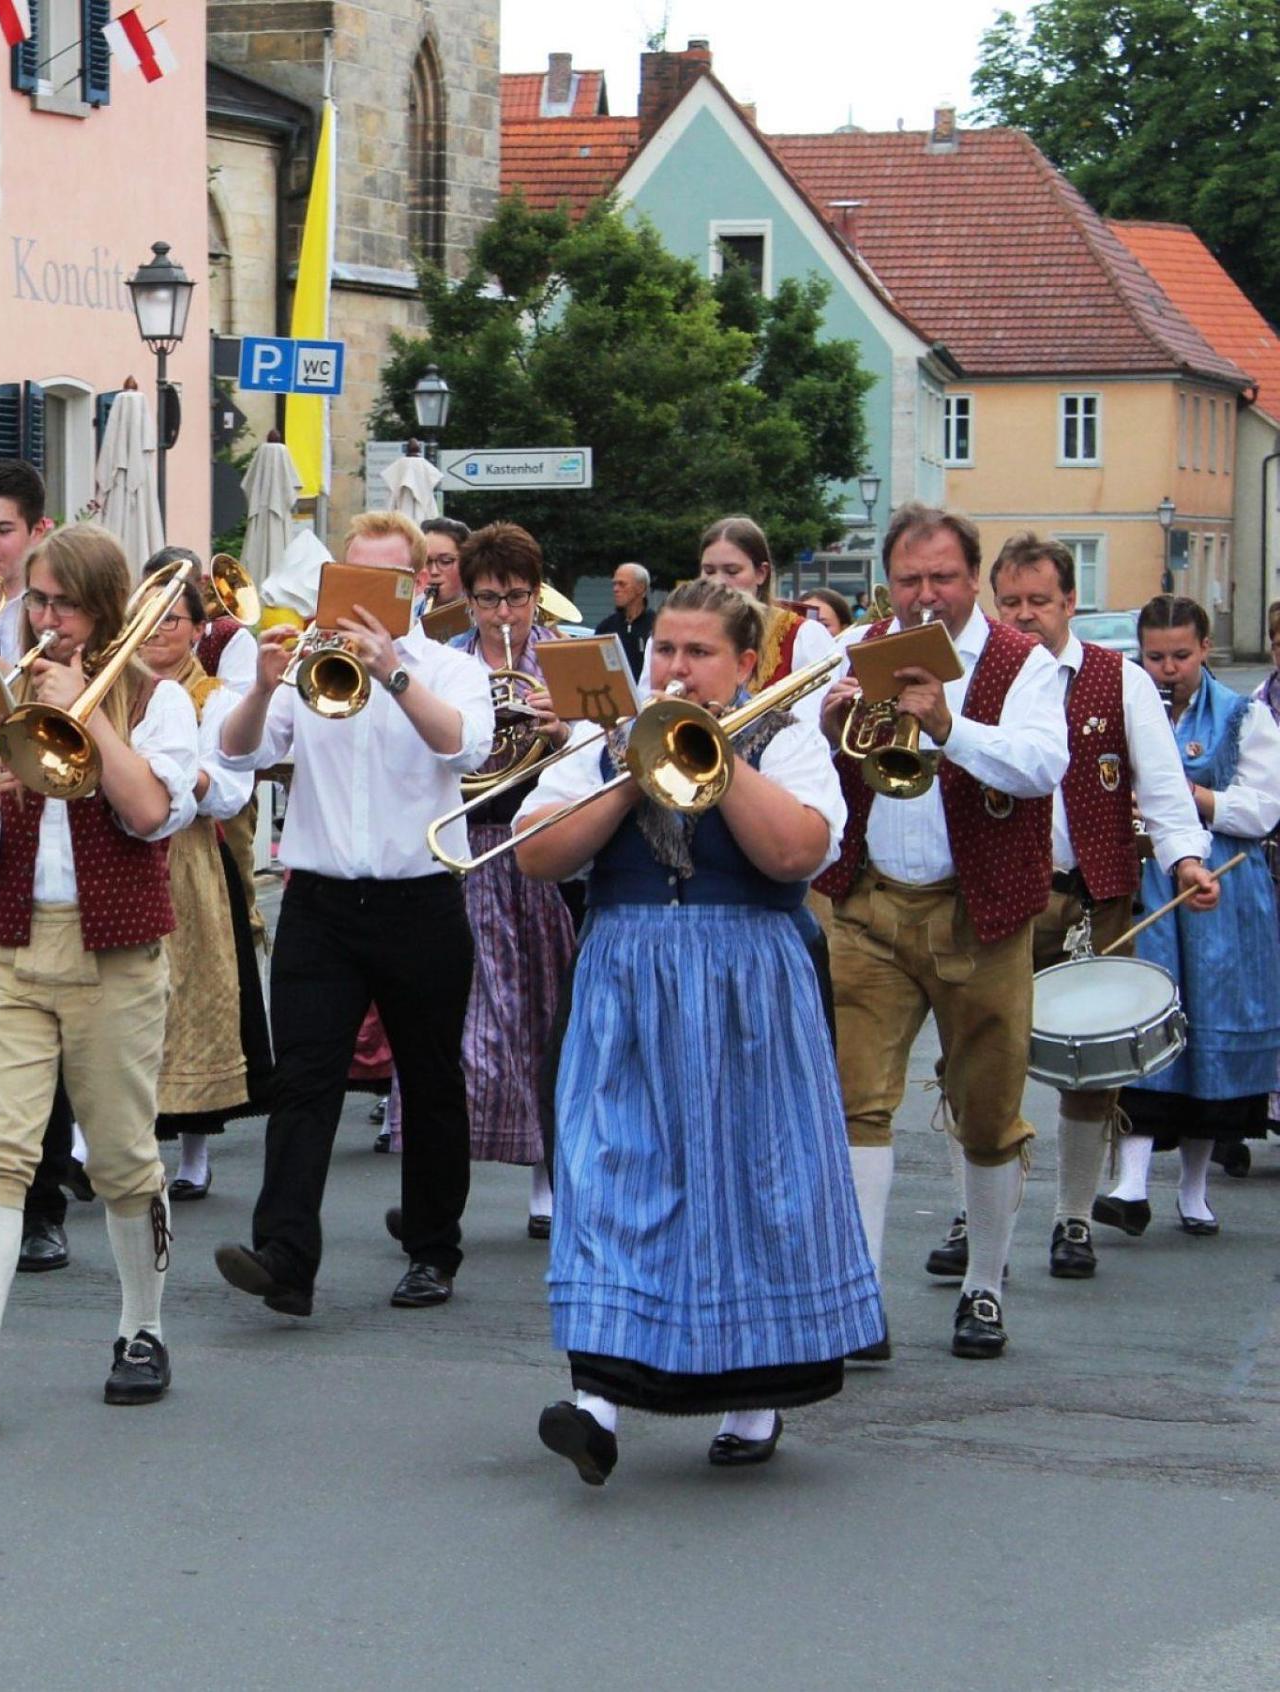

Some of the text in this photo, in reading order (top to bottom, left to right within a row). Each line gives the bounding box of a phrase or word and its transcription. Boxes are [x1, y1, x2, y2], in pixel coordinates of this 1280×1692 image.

[252, 344, 282, 384] P
[304, 360, 330, 375] WC
[485, 462, 544, 475] Kastenhof
